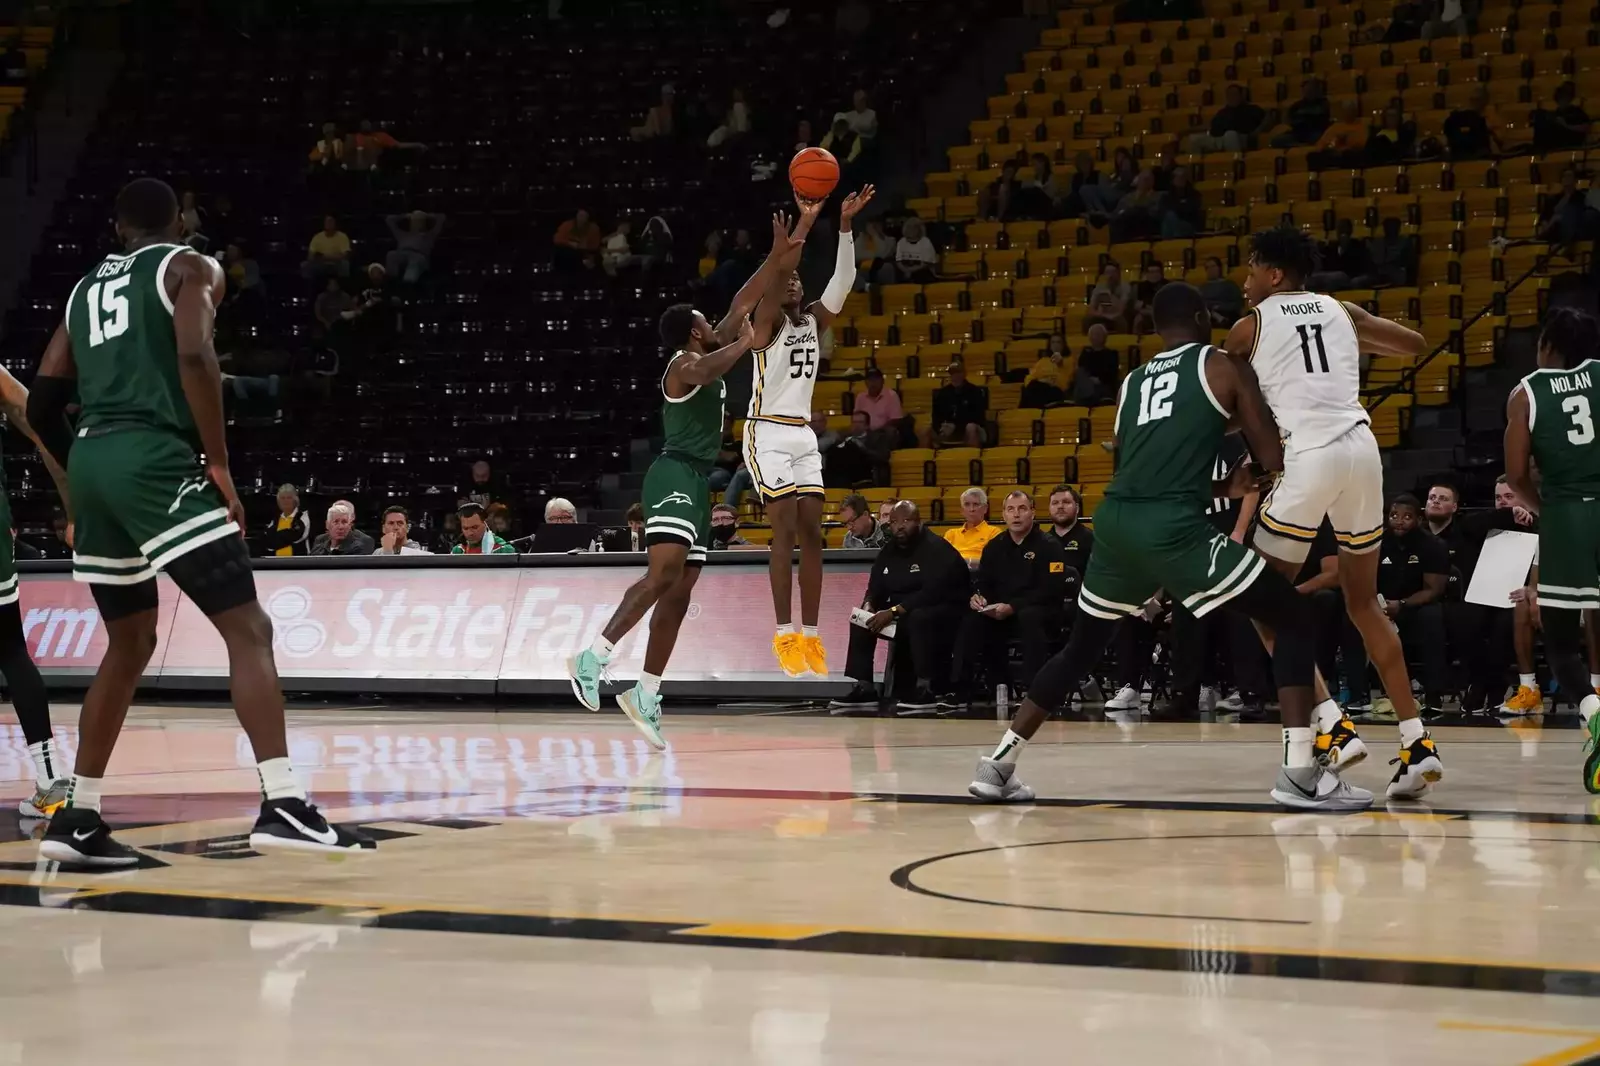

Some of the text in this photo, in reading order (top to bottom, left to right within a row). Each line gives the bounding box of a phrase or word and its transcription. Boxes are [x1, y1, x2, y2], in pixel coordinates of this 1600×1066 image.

[87, 273, 131, 347] 15
[1280, 301, 1324, 315] MOORE
[790, 348, 815, 378] 55
[1295, 323, 1330, 373] 11
[1137, 371, 1179, 425] 12
[1549, 371, 1592, 394] NOLAN
[1561, 395, 1595, 445] 3
